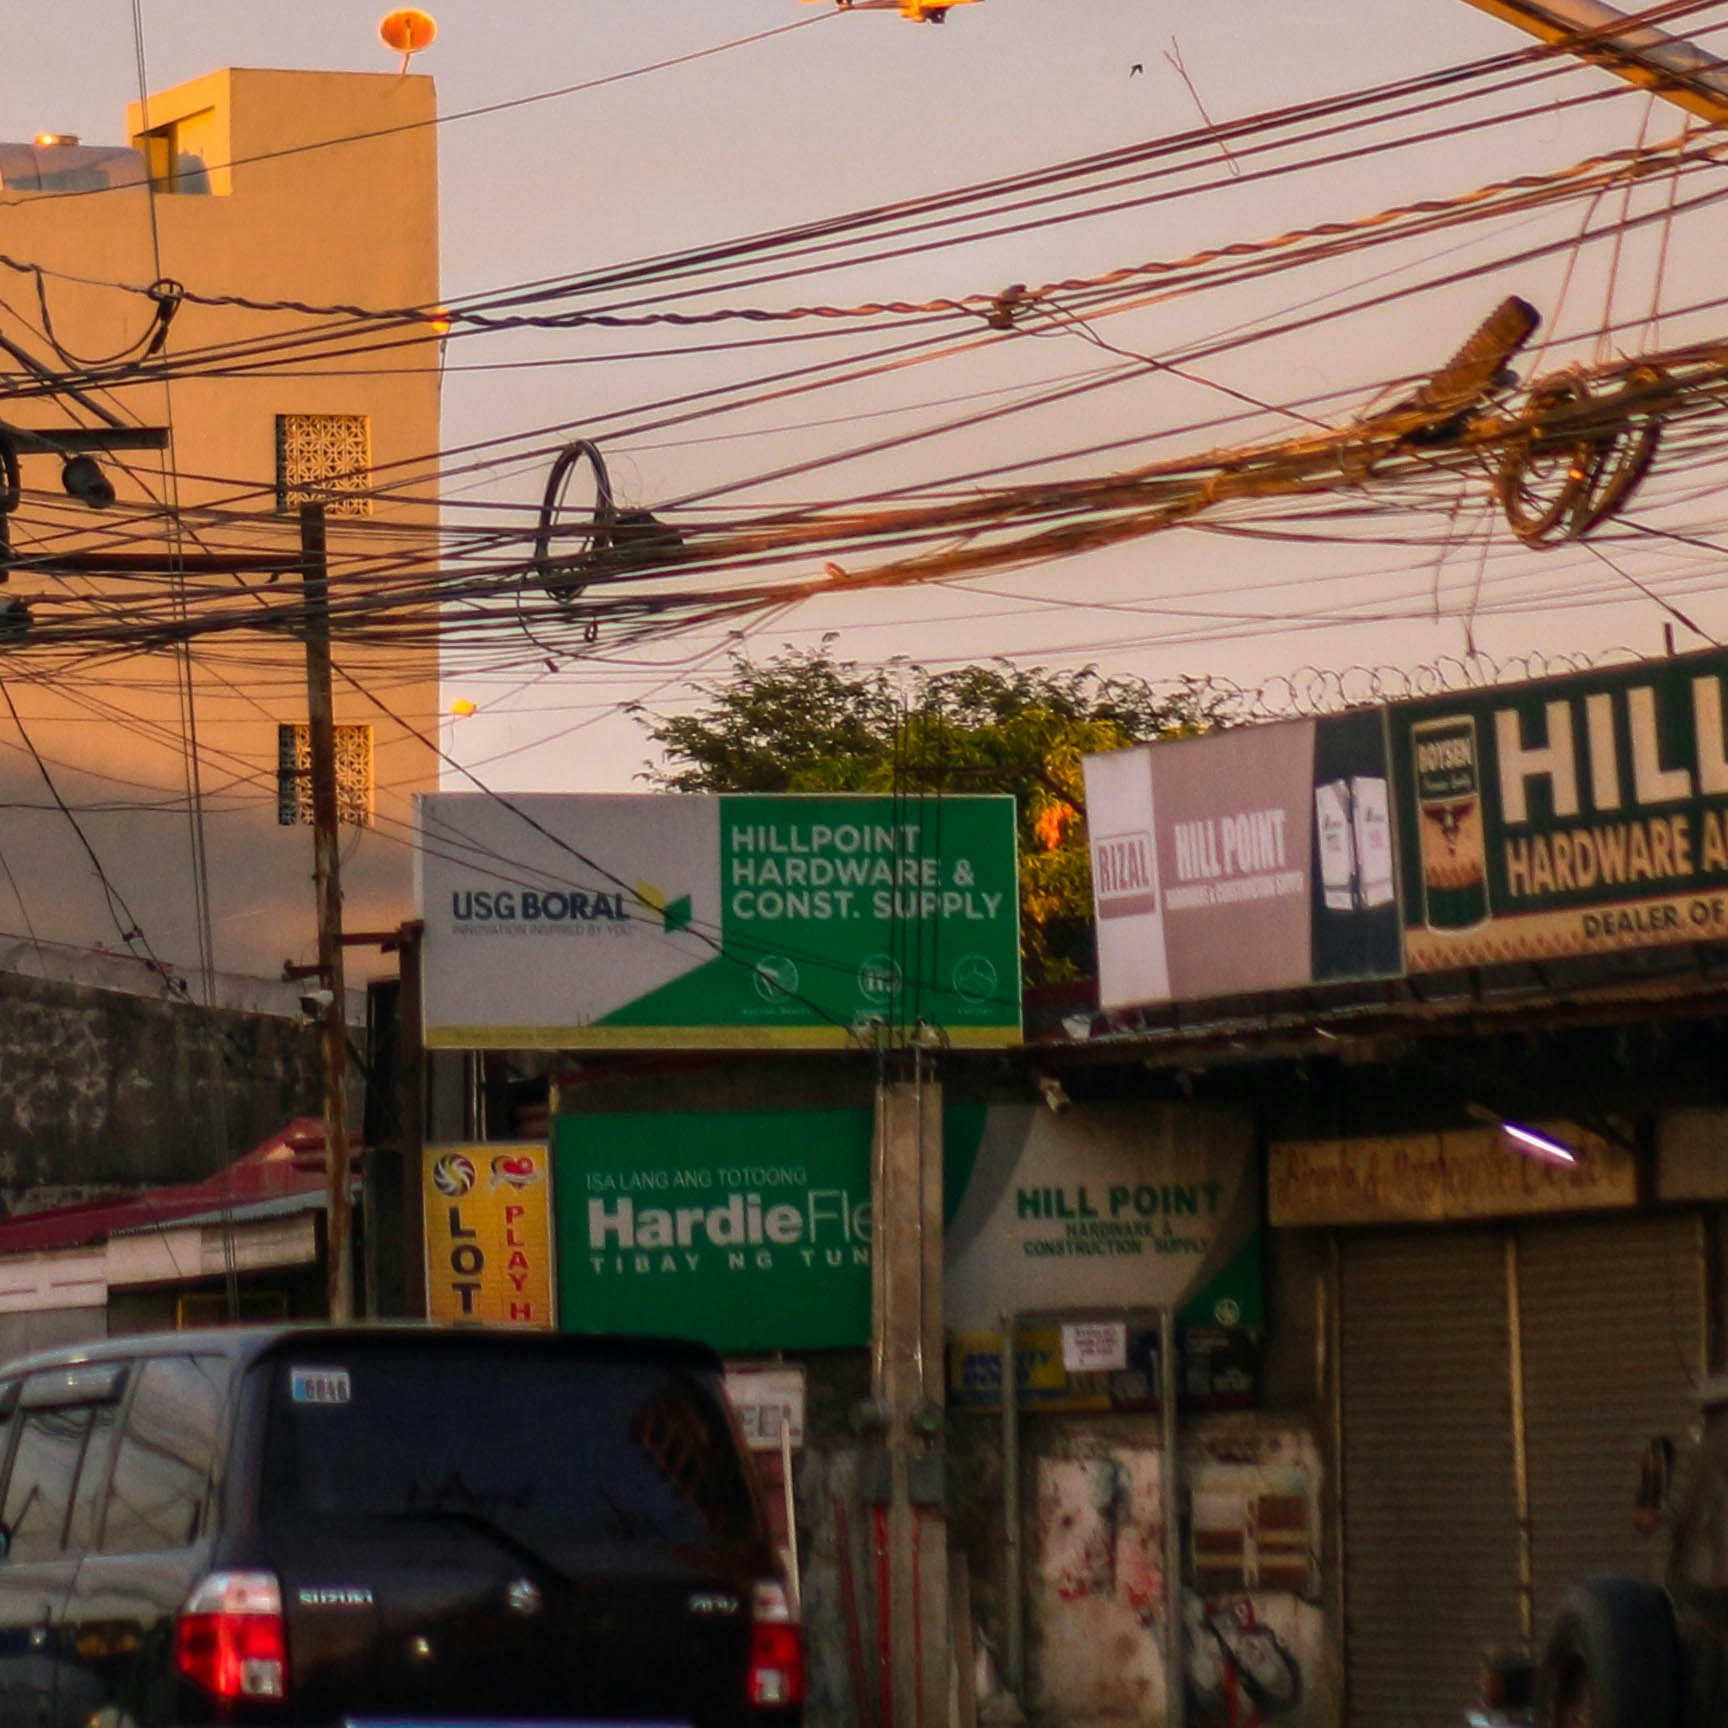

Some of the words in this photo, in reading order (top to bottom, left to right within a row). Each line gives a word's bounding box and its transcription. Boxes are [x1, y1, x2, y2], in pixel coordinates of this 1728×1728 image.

[731, 825, 921, 854] HILLPOINT
[1175, 820, 1223, 881] HILL
[1221, 808, 1285, 874] POINT
[732, 857, 941, 887] HARDWARE
[952, 859, 975, 887] &
[1098, 839, 1150, 892] RIZAL
[1505, 817, 1693, 897] HARDWARE
[453, 891, 515, 920] USG
[522, 891, 630, 920] BORAL
[732, 890, 861, 919] CONST.
[873, 891, 1002, 920] SUPPLY
[1581, 904, 1681, 941] DEALER
[1690, 897, 1727, 928] OF
[586, 1171, 616, 1191] ISA
[619, 1170, 669, 1190] LANG
[673, 1169, 712, 1188] ANG
[718, 1167, 808, 1187] TOTOONG
[1017, 1188, 1097, 1219] HILL
[1109, 1183, 1220, 1215] POINT
[589, 1250, 701, 1274] TIBAY
[728, 1252, 774, 1270] NG
[1023, 1239, 1141, 1258] CONSTRUCTION
[1156, 1237, 1208, 1255] SUPPLY
[298, 1588, 375, 1605] SUZUKI
